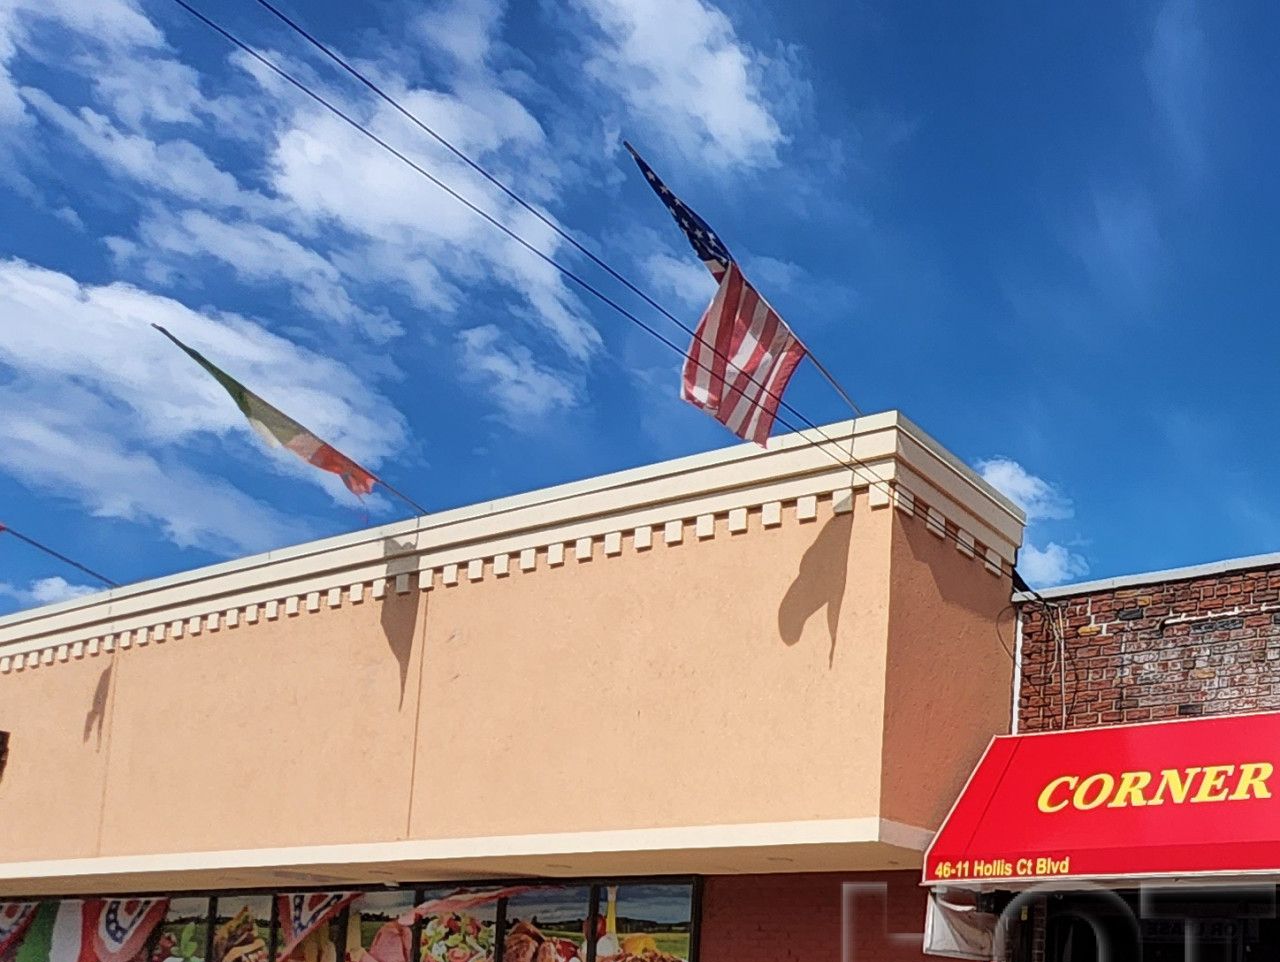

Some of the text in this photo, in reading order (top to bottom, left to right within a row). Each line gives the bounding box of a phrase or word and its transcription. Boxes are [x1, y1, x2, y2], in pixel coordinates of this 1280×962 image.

[1036, 762, 1274, 814] CORNER
[934, 856, 1070, 878] 46-11 Hollis Ct Blvd
